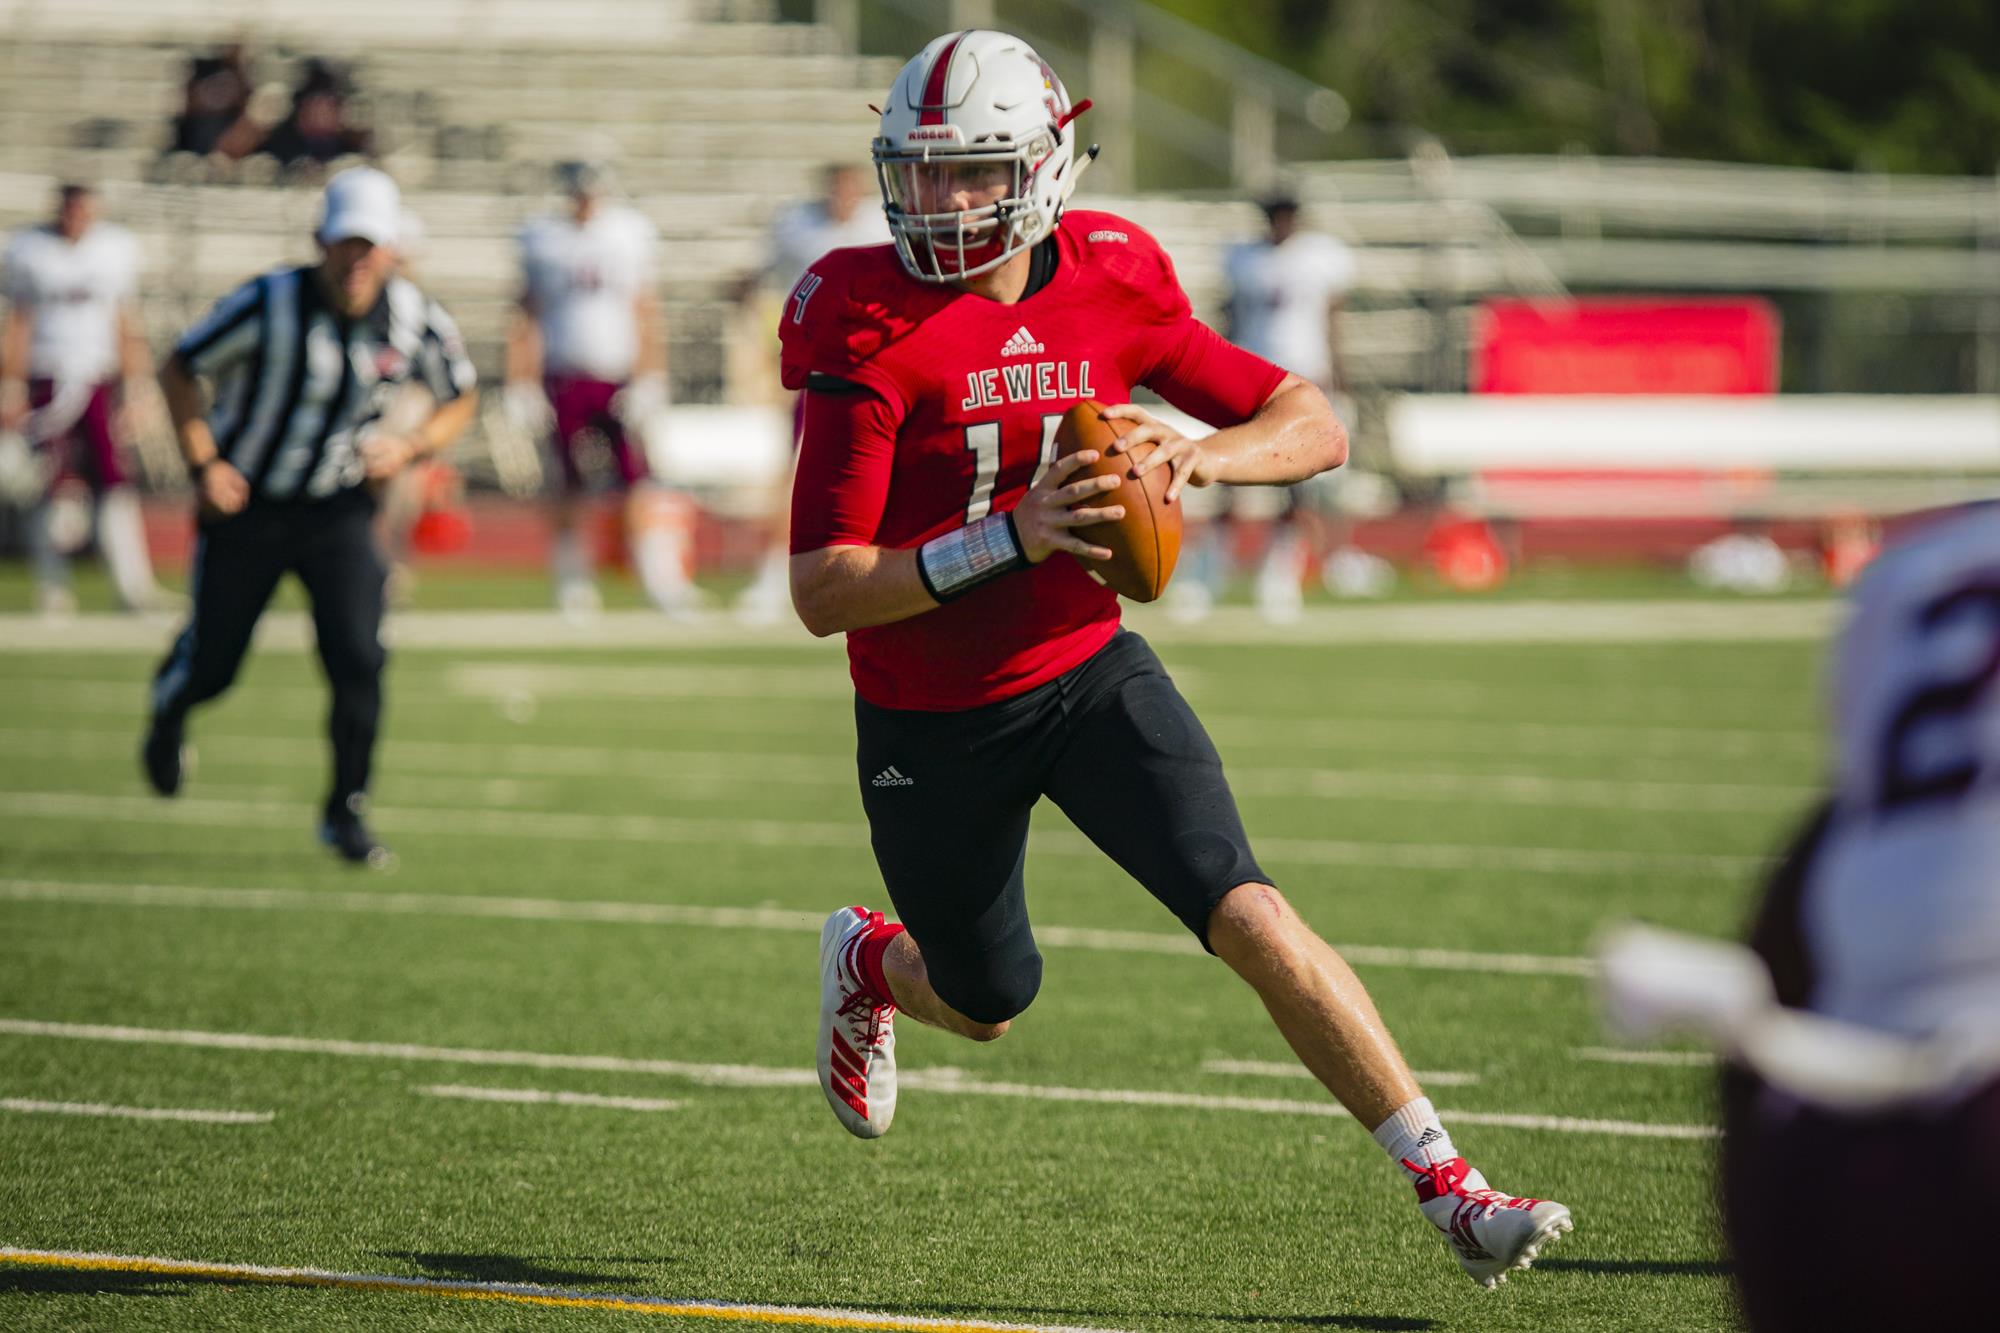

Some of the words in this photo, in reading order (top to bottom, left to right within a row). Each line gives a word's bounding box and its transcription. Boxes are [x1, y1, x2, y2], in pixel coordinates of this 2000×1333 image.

[1000, 341, 1045, 358] adidas
[962, 361, 1095, 411] JEWELL
[871, 777, 914, 787] adidas
